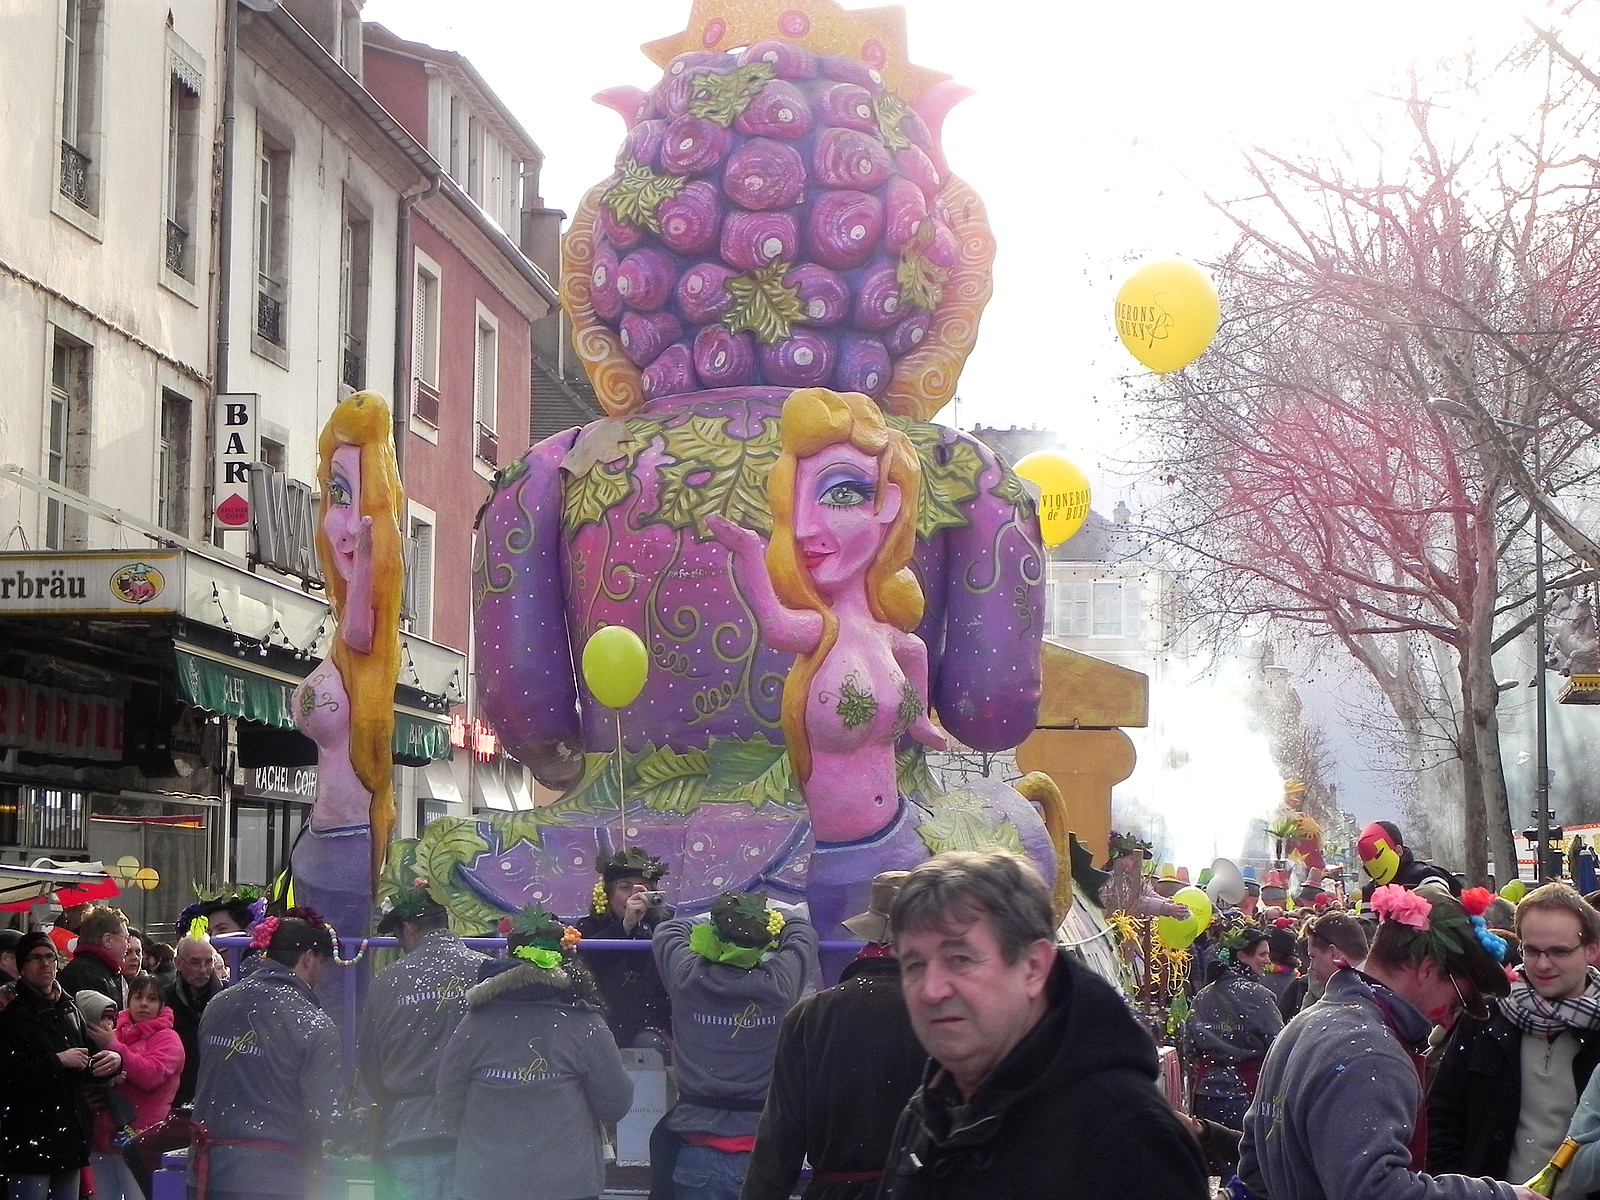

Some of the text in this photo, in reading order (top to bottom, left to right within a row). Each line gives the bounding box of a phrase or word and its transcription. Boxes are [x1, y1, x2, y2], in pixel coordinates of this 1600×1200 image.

[224, 403, 250, 485] BAR
[0, 569, 87, 600] rbräu
[255, 765, 289, 793] RACHEL
